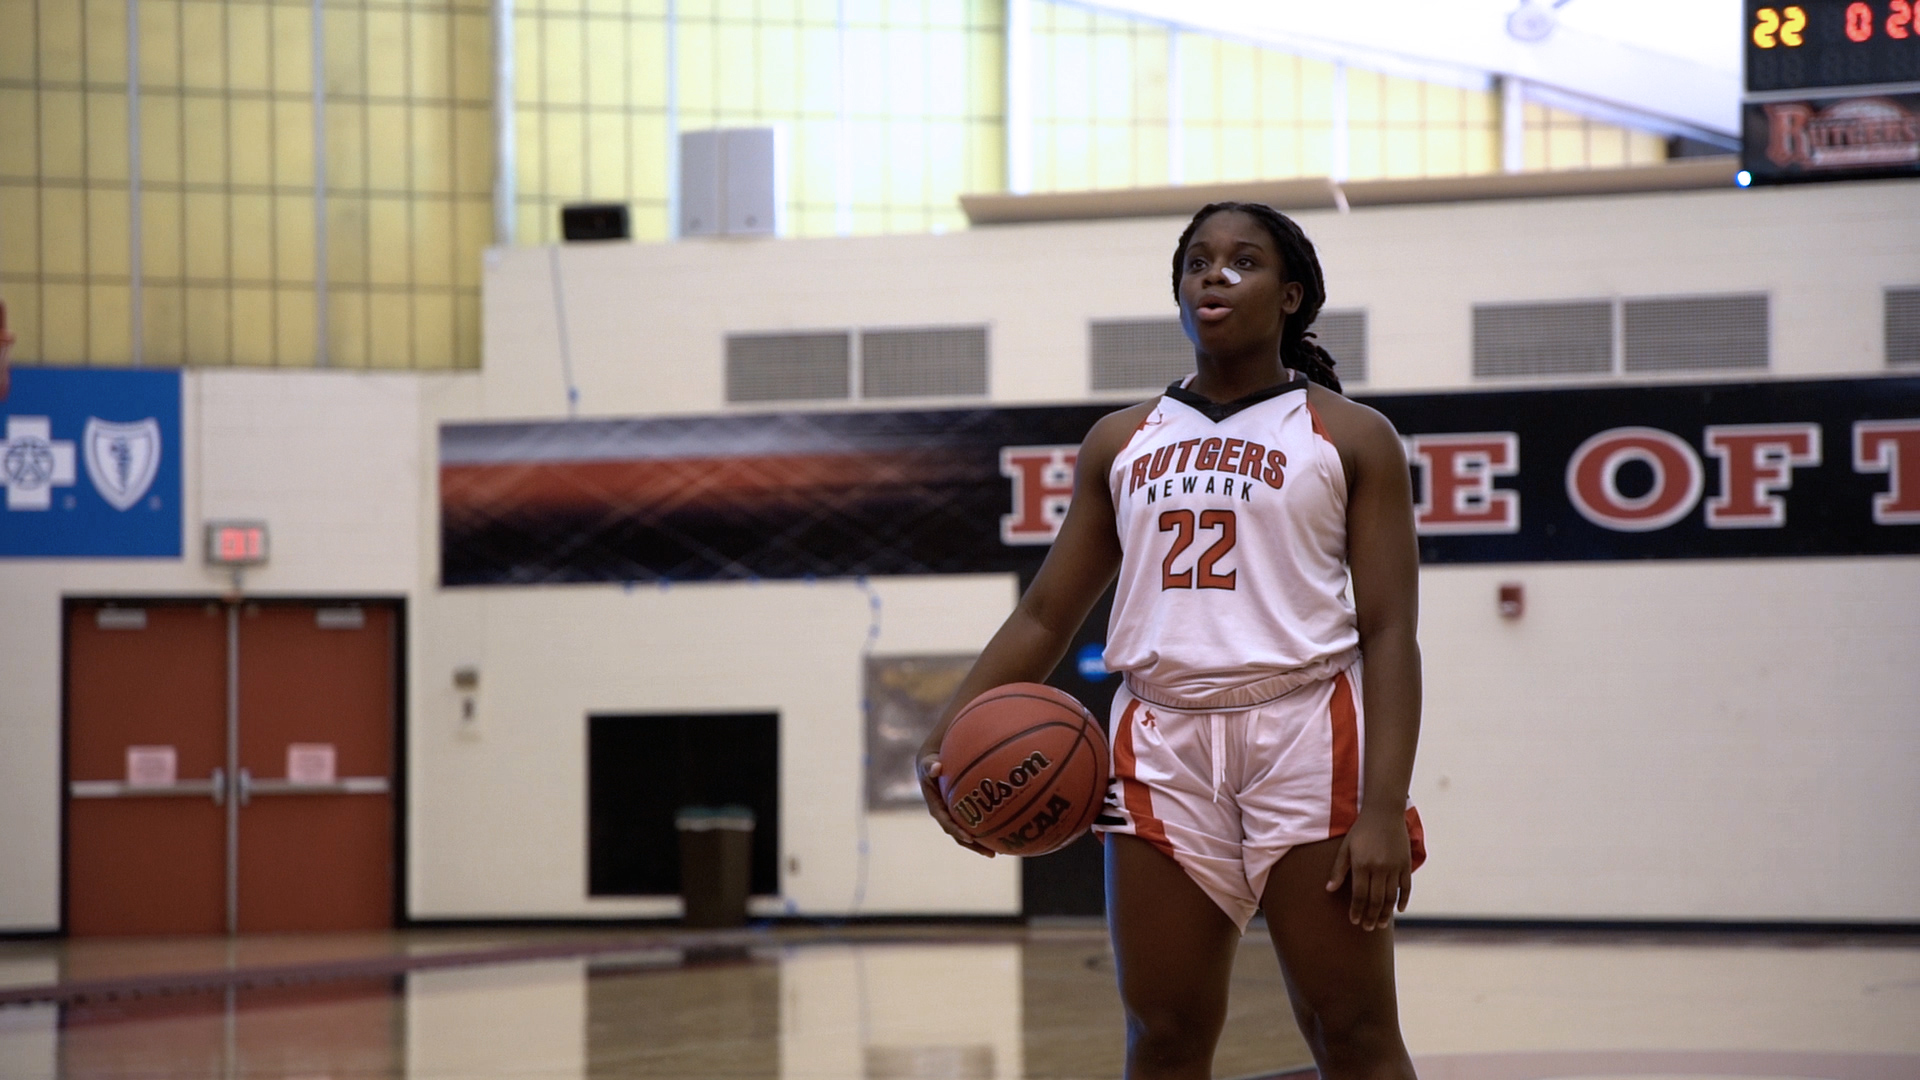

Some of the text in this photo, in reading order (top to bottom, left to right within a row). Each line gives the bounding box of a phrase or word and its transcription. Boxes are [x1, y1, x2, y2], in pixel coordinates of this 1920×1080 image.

[1753, 6, 1806, 48] 22
[1846, 0, 1920, 42] 0 2
[1000, 432, 1520, 545] HE
[1565, 422, 1822, 532] OF
[1129, 437, 1287, 498] RUTGERS
[1147, 475, 1253, 505] NEWARK
[1158, 509, 1236, 591] 22
[953, 751, 1053, 828] Wilson
[999, 794, 1071, 850] NCAA
